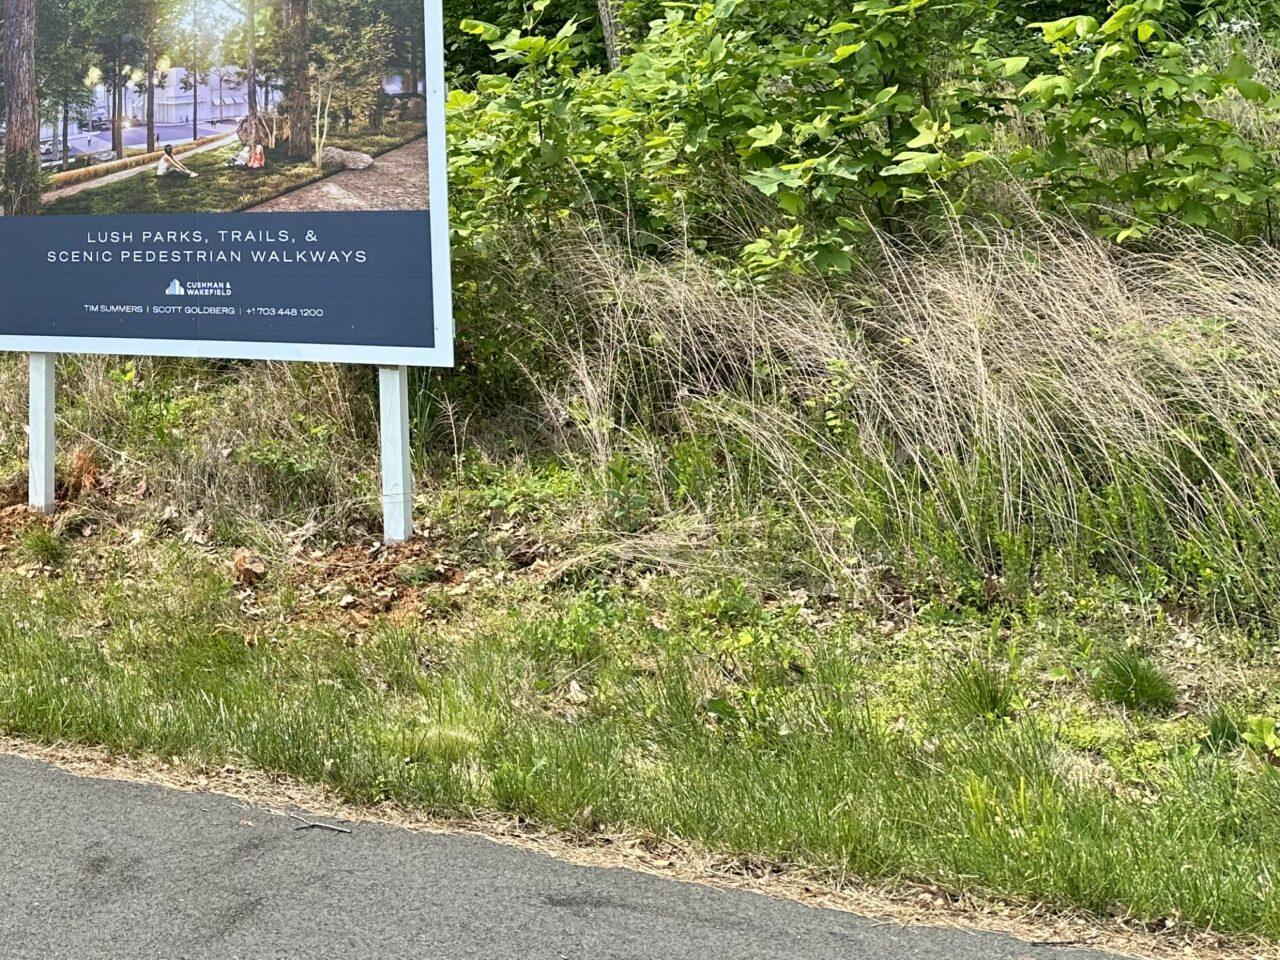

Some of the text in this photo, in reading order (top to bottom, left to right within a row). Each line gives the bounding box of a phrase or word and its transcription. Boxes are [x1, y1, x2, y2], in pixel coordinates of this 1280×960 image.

[87, 229, 319, 244] LUSH PARKS, TRAILS, &
[47, 250, 368, 263] SCENIC PEDESTRIAN WALKWAYS
[186, 281, 231, 289] CUSHMAN &
[186, 288, 232, 296] WAKEFIELD
[84, 304, 99, 313] TIM
[100, 305, 143, 313] SUMMERS
[152, 305, 182, 314] SCOTT
[184, 306, 235, 315] GOLDBERG
[257, 308, 277, 317] 703
[277, 308, 298, 317] 448
[299, 309, 324, 318] 1200
